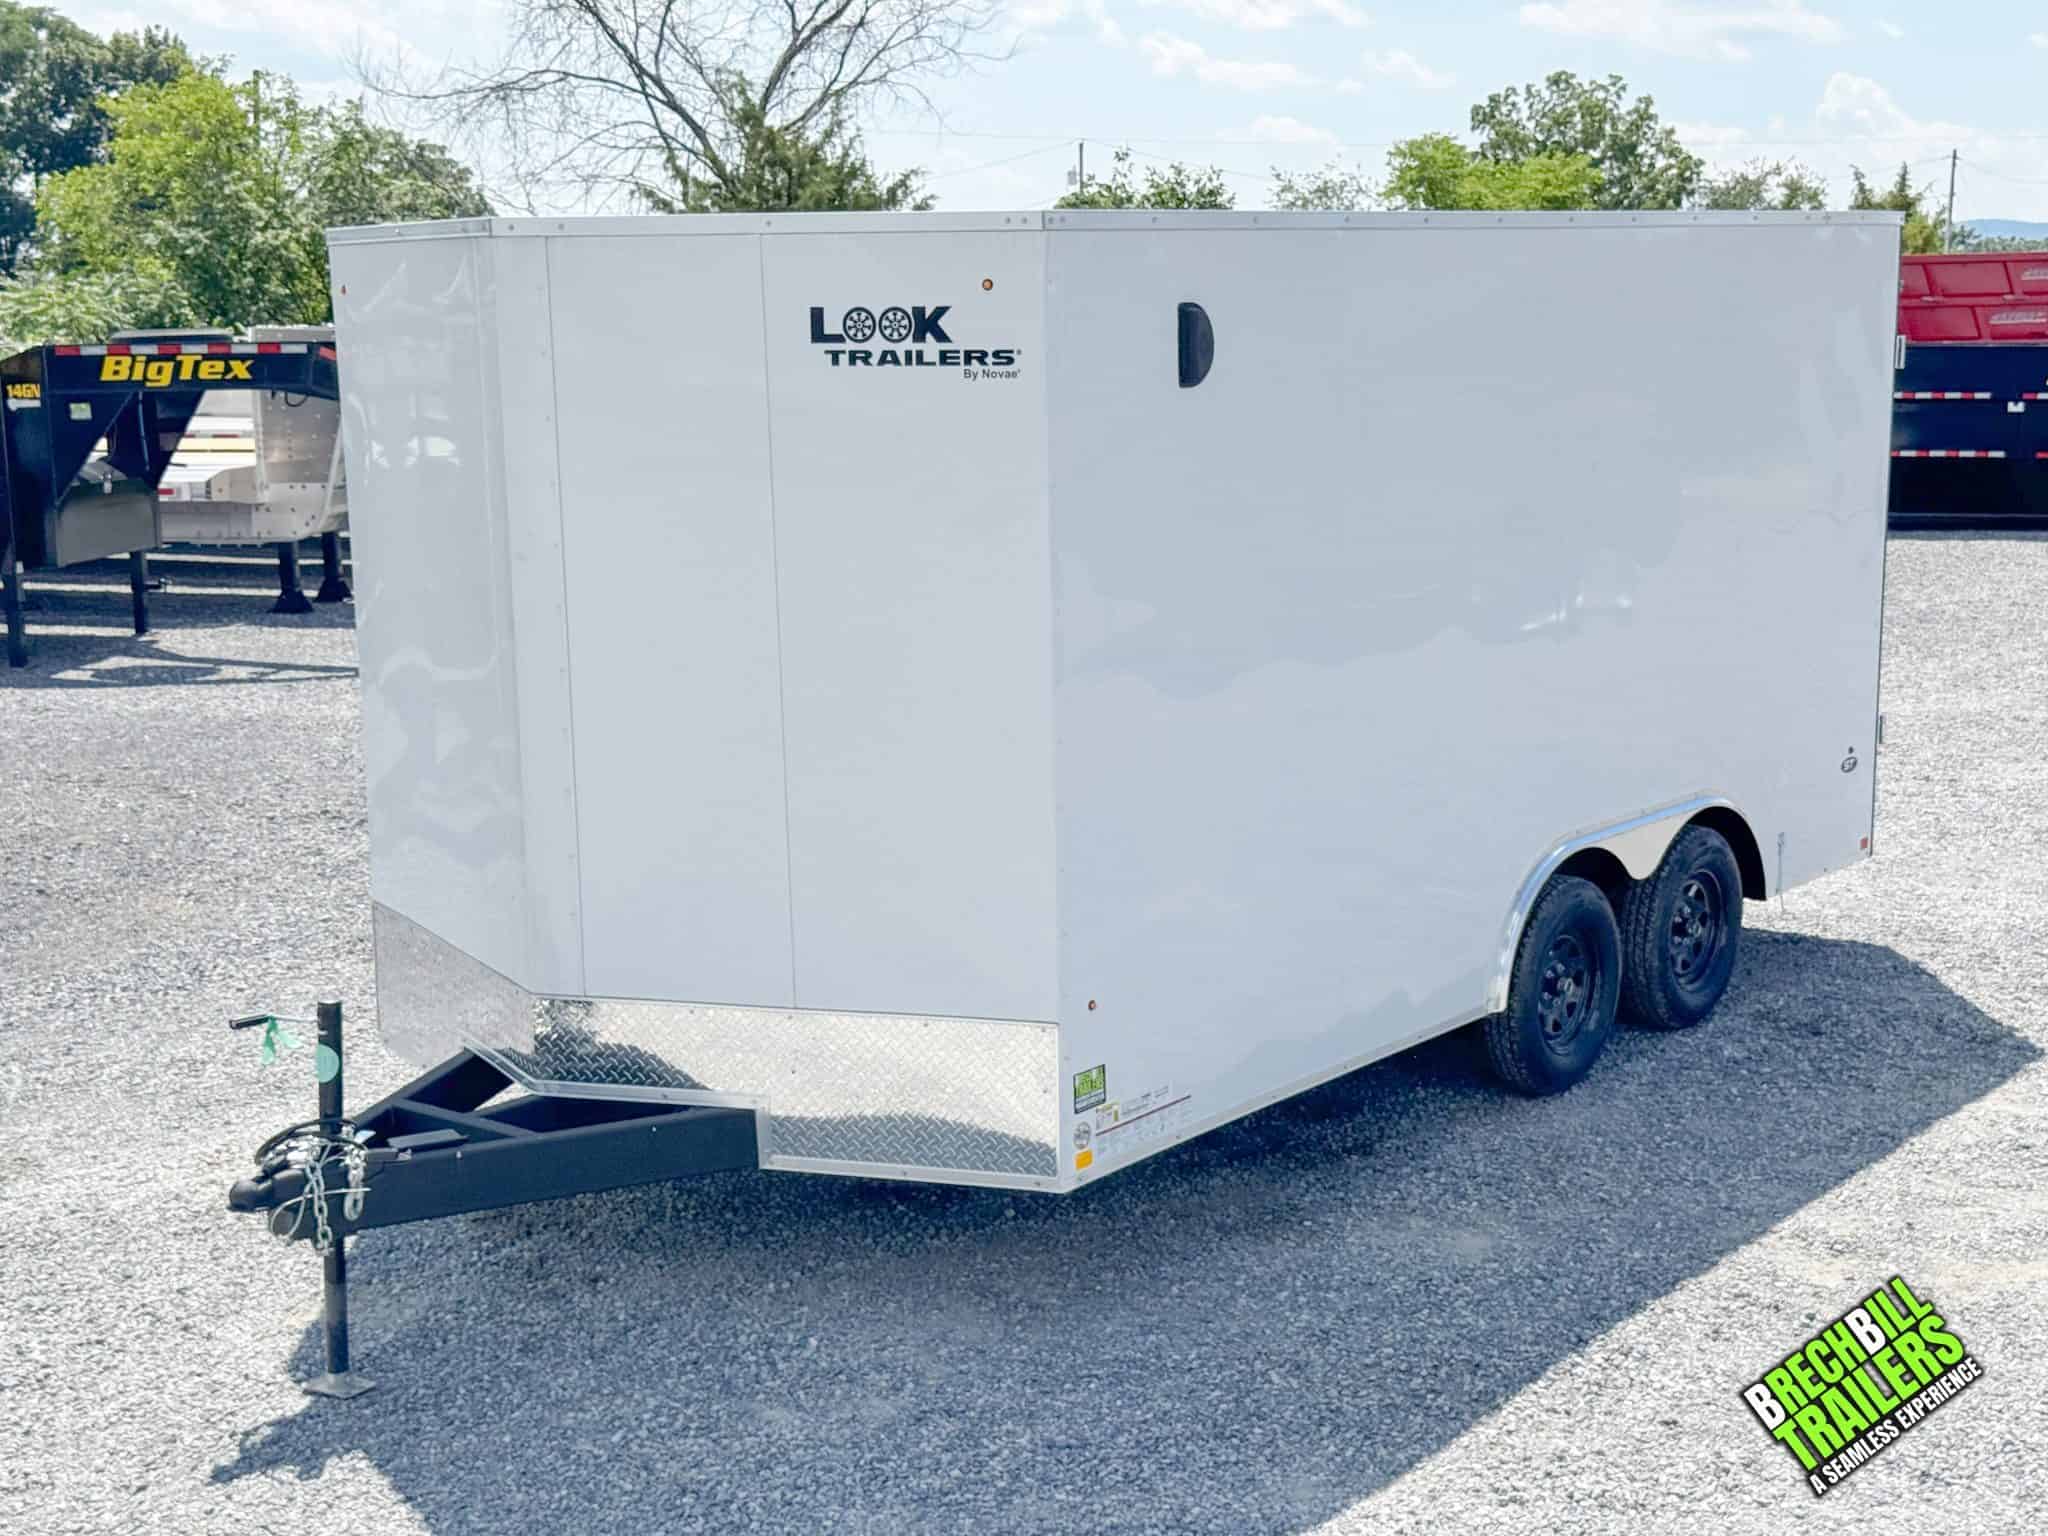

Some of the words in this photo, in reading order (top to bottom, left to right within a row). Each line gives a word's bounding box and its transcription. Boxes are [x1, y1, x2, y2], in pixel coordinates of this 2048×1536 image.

[810, 306, 953, 343] LOOK
[100, 355, 255, 387] BigTex
[963, 368, 979, 381] By
